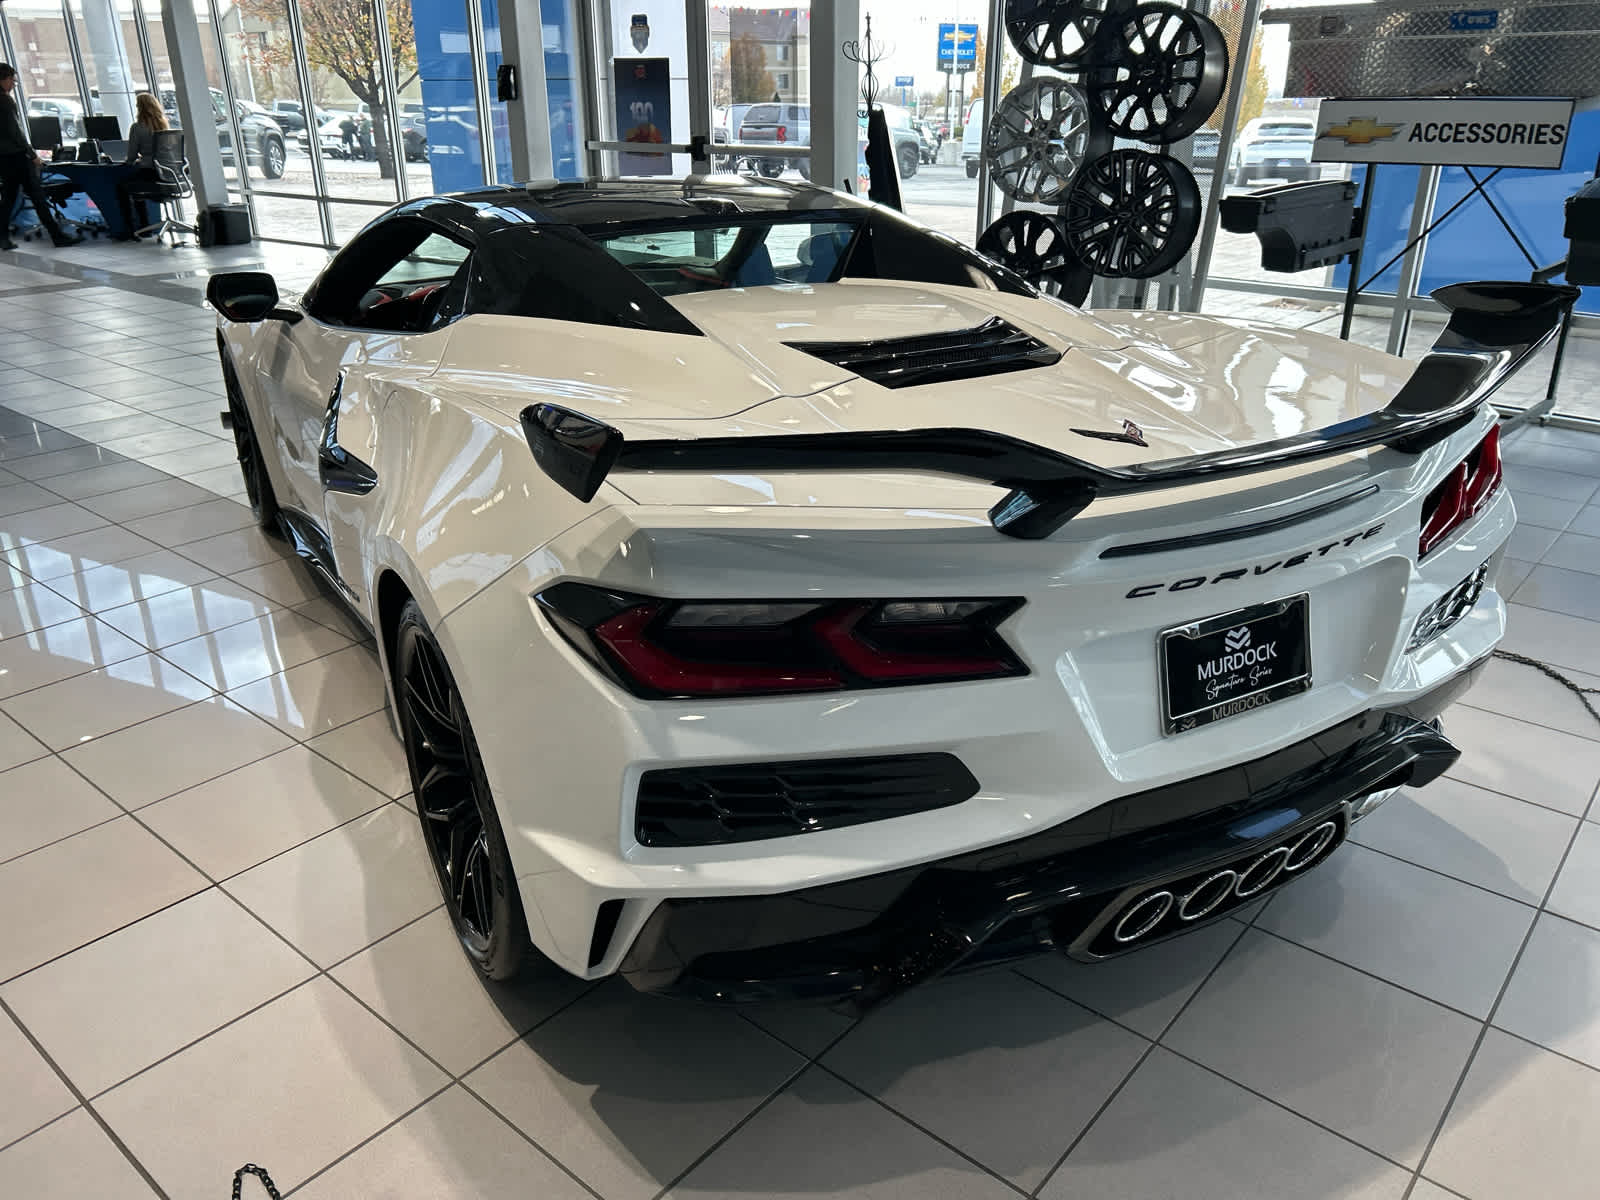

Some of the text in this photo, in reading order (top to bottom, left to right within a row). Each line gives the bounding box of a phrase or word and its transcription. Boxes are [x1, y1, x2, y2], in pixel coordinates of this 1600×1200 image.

[1408, 122, 1566, 145] ACCESSORIES
[1125, 522, 1387, 599] CORVETTE
[1197, 641, 1278, 681] MURDOCK
[1205, 666, 1273, 700] Signature Series
[1212, 692, 1272, 721] MURDOCK
